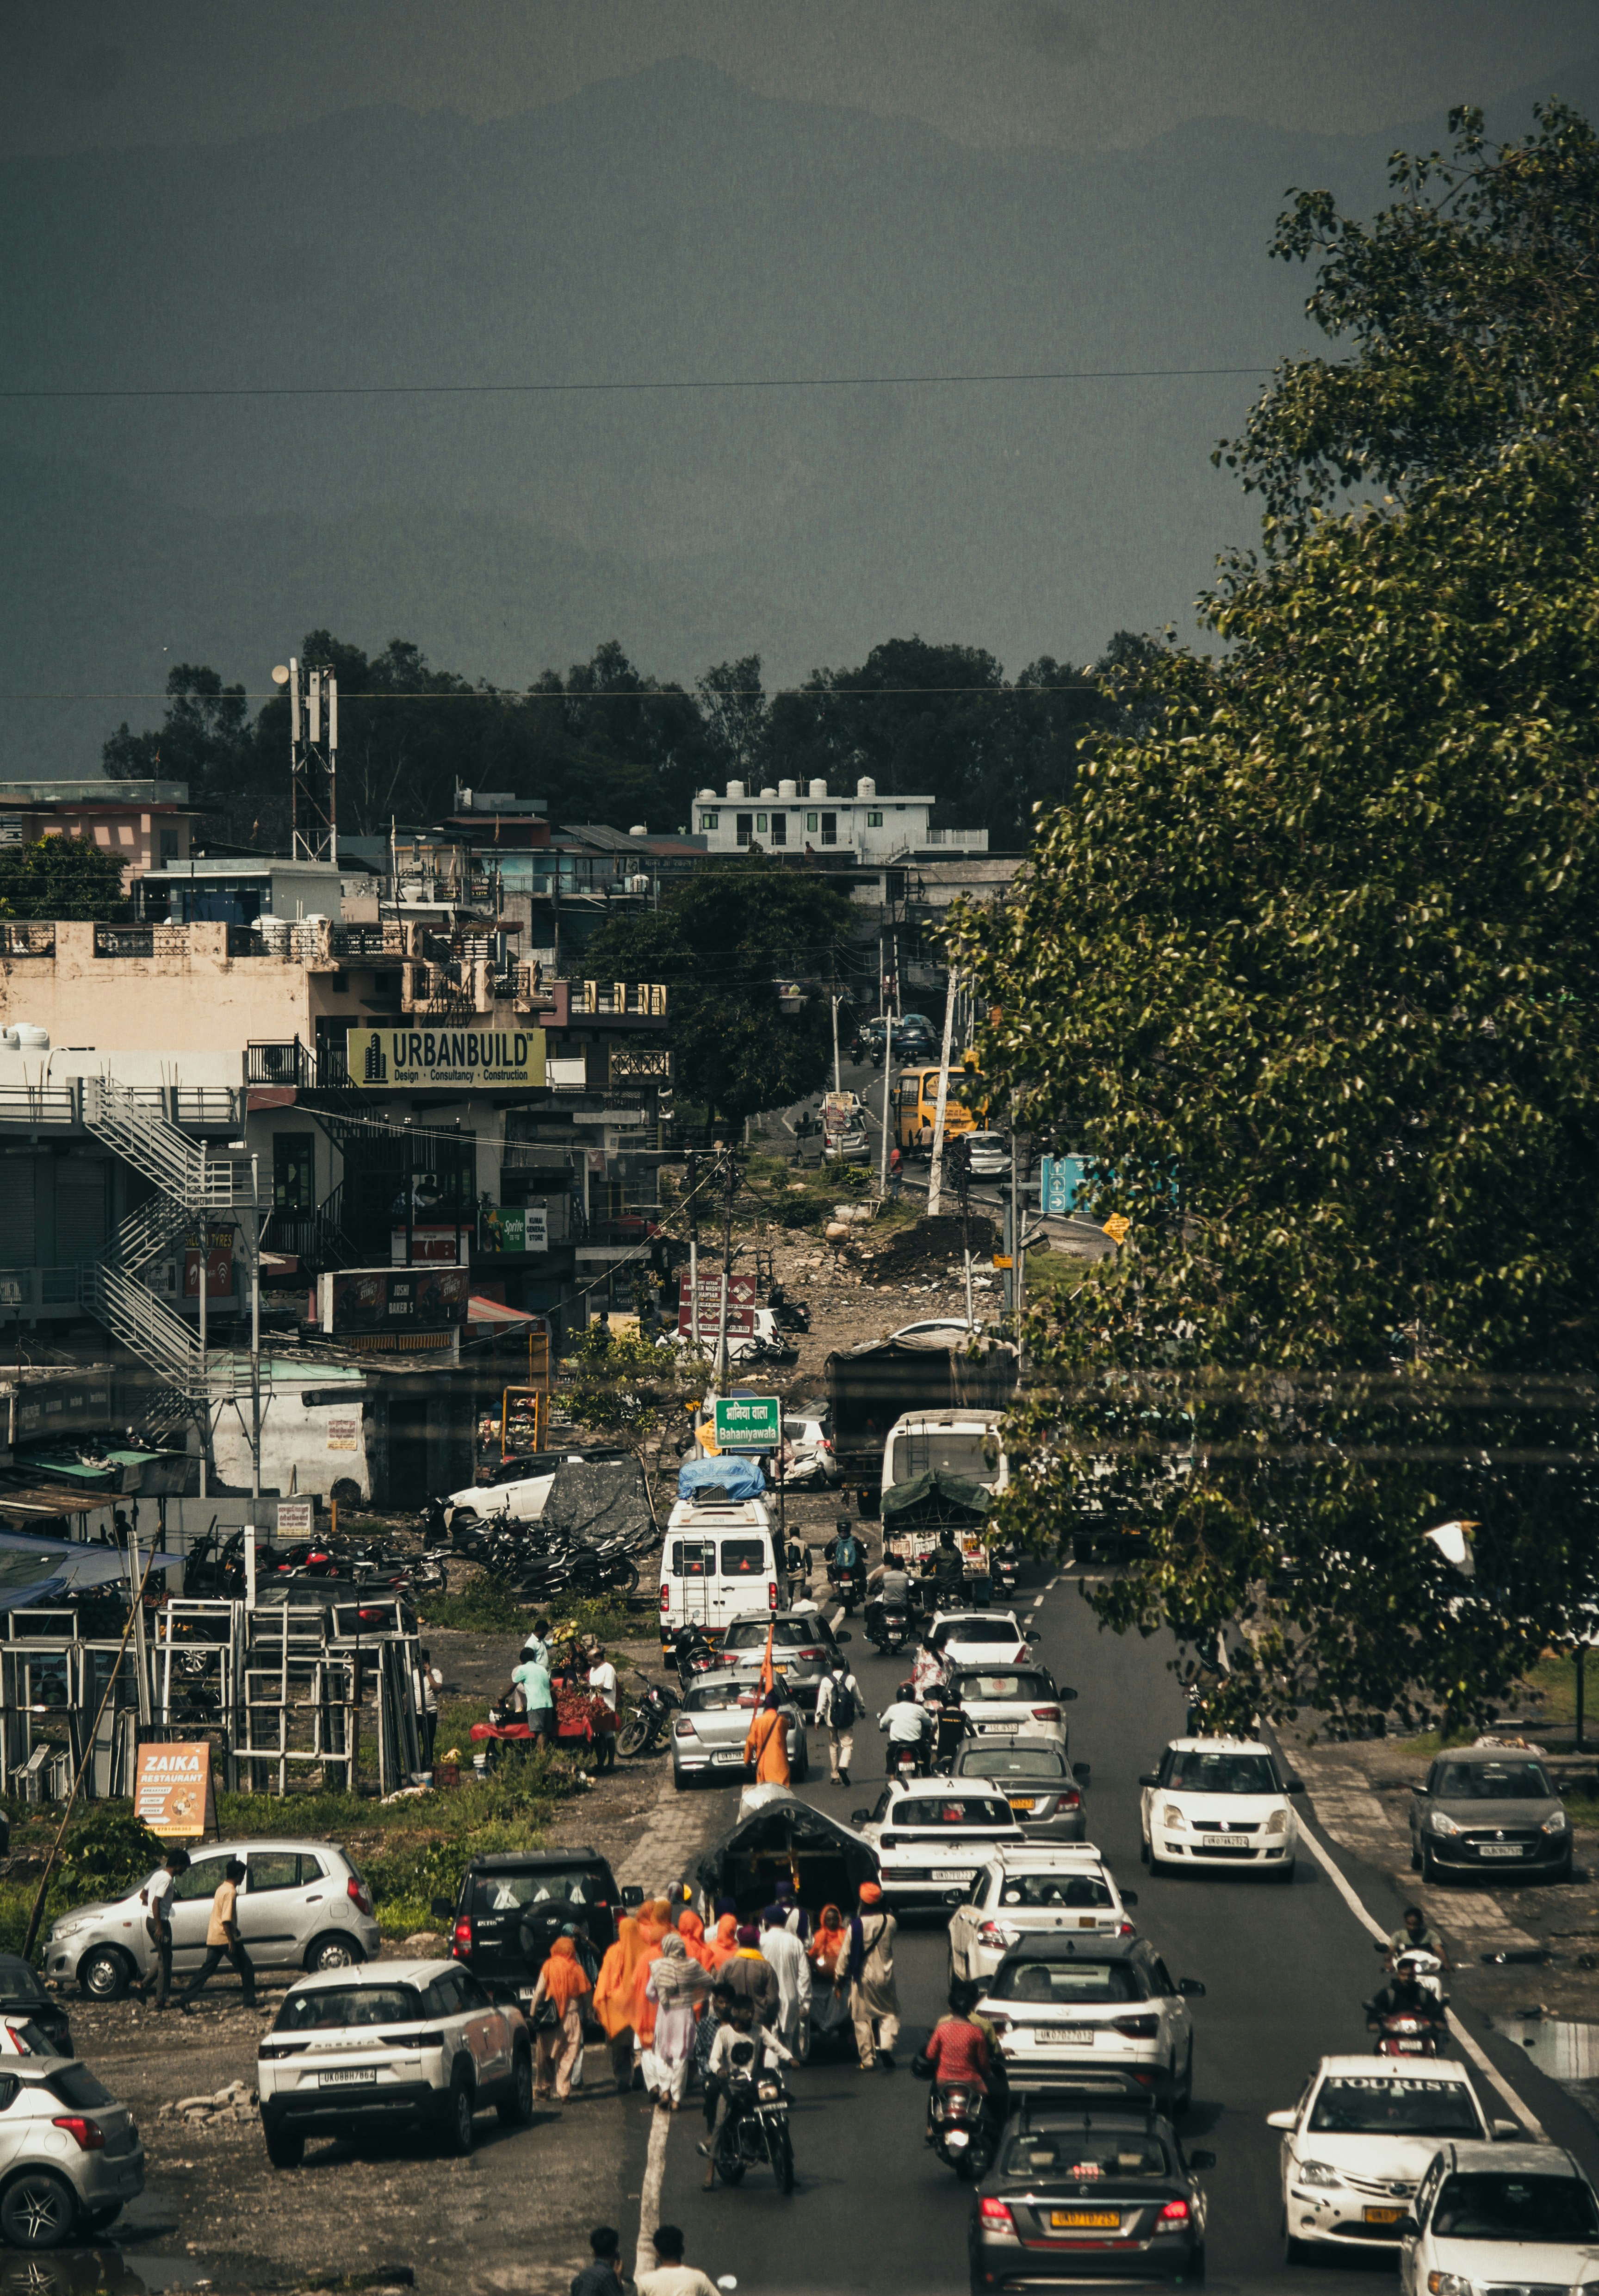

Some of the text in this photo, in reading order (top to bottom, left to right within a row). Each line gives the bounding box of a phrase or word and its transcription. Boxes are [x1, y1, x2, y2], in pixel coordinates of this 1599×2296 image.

[393, 1033, 527, 1067] URBANBUILD
[394, 1068, 528, 1083] Design Consultancy Construction
[504, 1219, 524, 1236] Sprite
[211, 1233, 232, 1247] TYRES
[393, 1284, 409, 1296] JOSHI
[388, 1302, 407, 1314] BAKER
[726, 1401, 768, 1420] भानिया वाला
[719, 1426, 776, 1442] Bahaniyawala
[144, 1755, 199, 1771] ZAIKA
[141, 1774, 203, 1783] RESTAURANT
[1330, 2078, 1462, 2093] TOURIST
